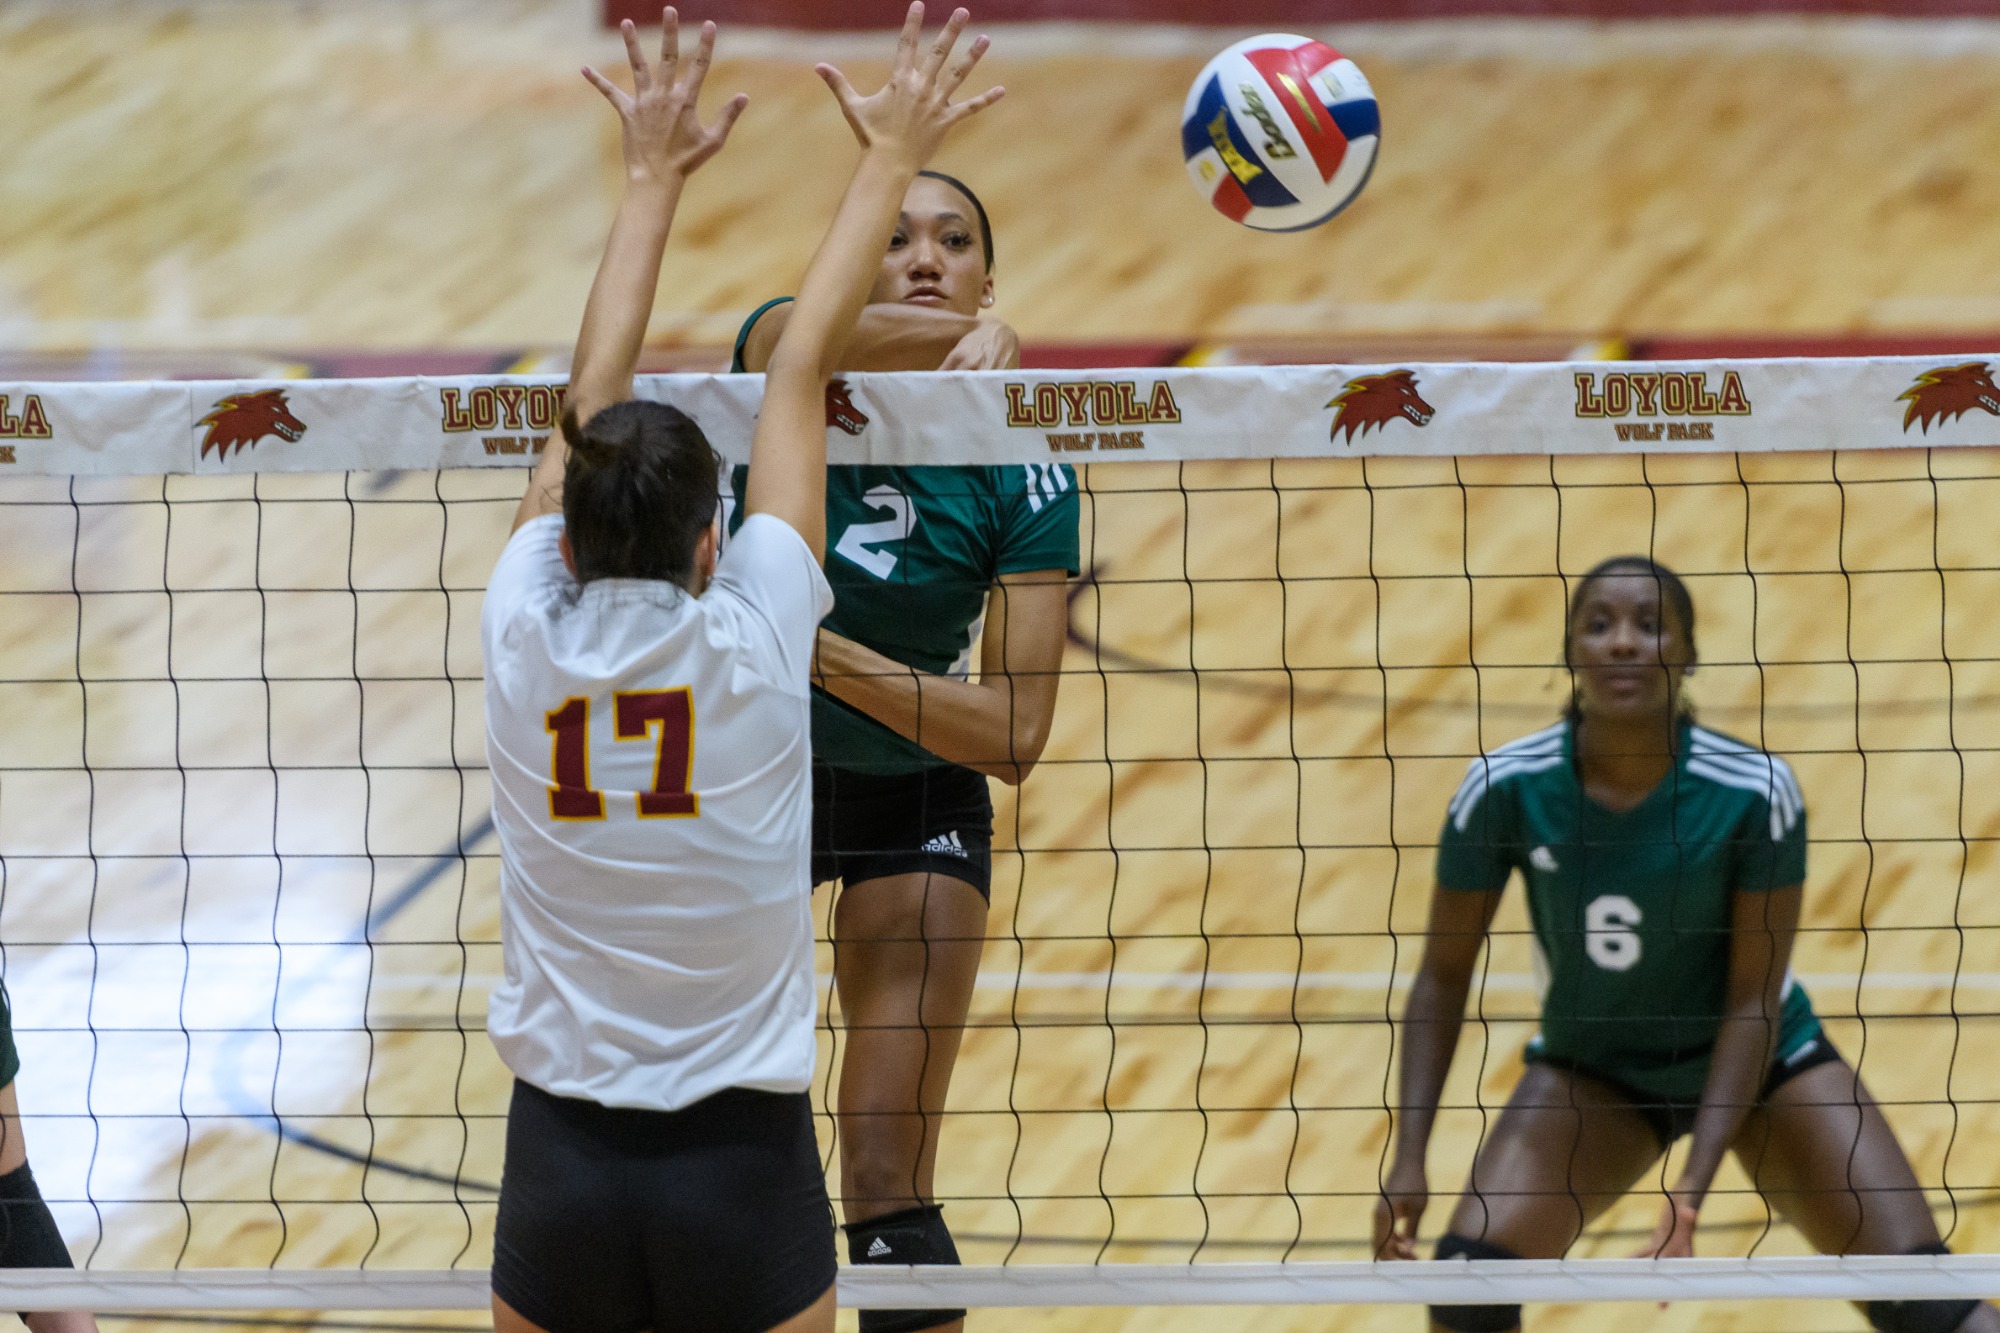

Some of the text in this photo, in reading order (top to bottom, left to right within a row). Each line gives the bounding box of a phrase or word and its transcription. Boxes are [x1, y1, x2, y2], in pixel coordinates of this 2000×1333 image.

[440, 385, 569, 432] LOYO
[1005, 380, 1182, 427] LOYOLA
[1574, 371, 1752, 417] LOYOLA
[1046, 431, 1145, 452] WOLF PACK
[1614, 422, 1714, 441] WOLF PACK
[834, 484, 917, 581] 2
[545, 684, 700, 822] 17
[1585, 894, 1643, 972] 6
